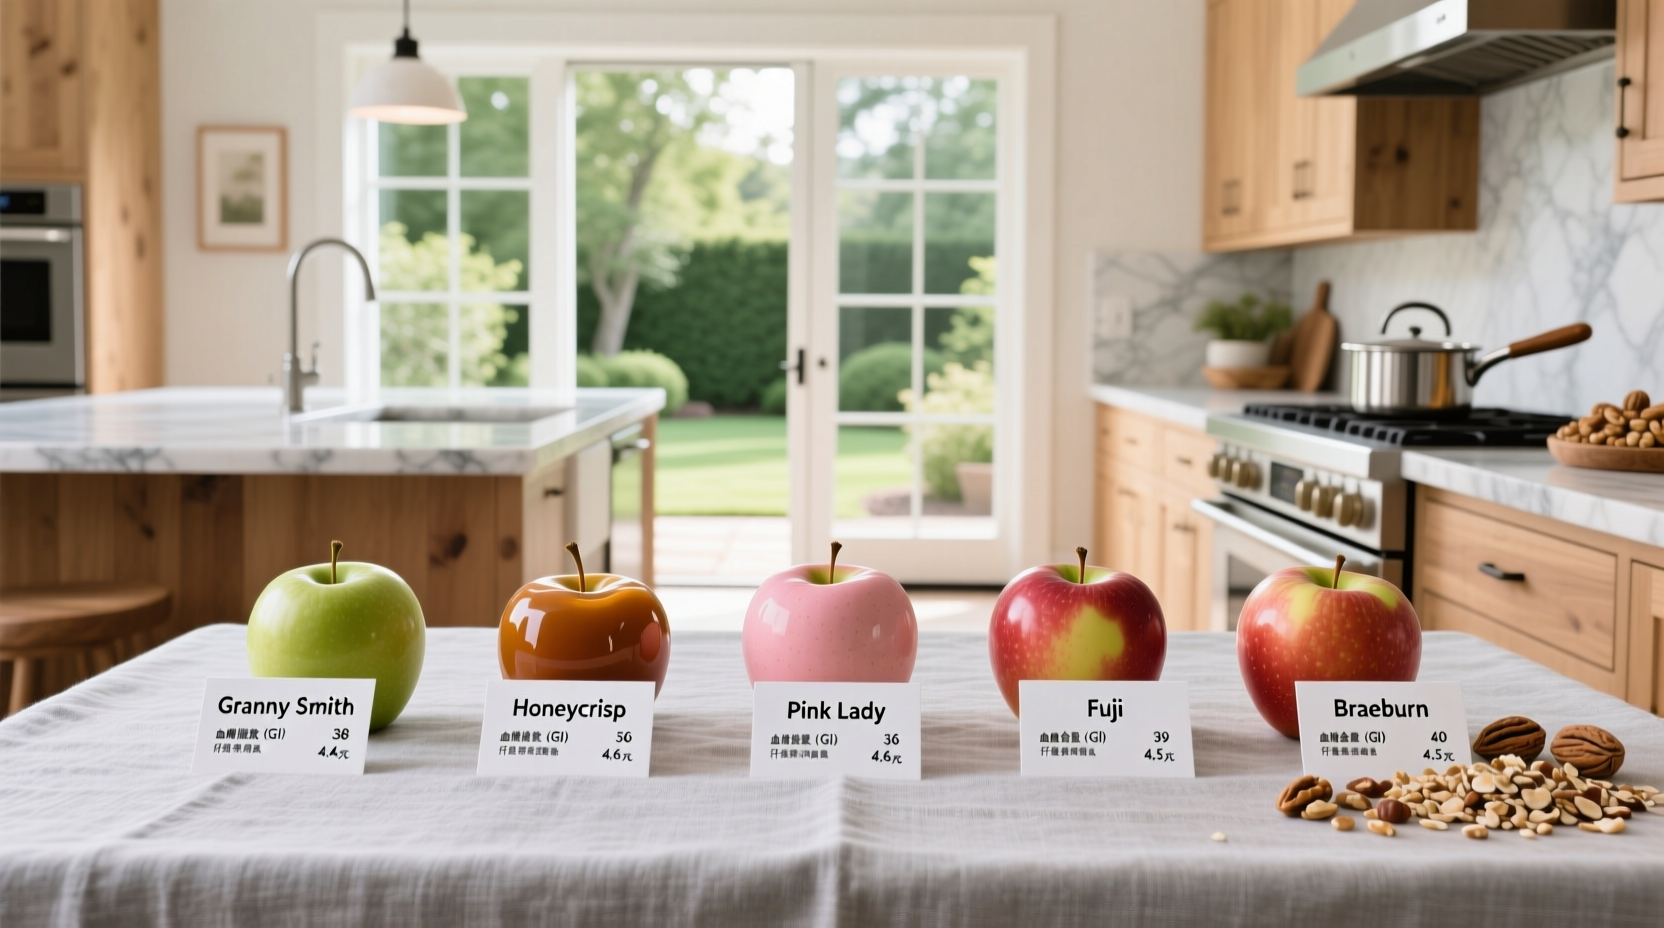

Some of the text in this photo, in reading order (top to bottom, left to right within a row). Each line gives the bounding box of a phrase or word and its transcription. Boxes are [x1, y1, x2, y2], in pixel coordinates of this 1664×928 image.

[218, 696, 355, 720] Granny Smith
[512, 698, 627, 723] Honeycrisp
[787, 700, 886, 725] Pink Lady
[1087, 698, 1124, 723] Fuji
[1333, 698, 1429, 718] Braeburn
[883, 733, 900, 746] 36
[1153, 731, 1170, 743] 39
[1430, 731, 1448, 743] 40
